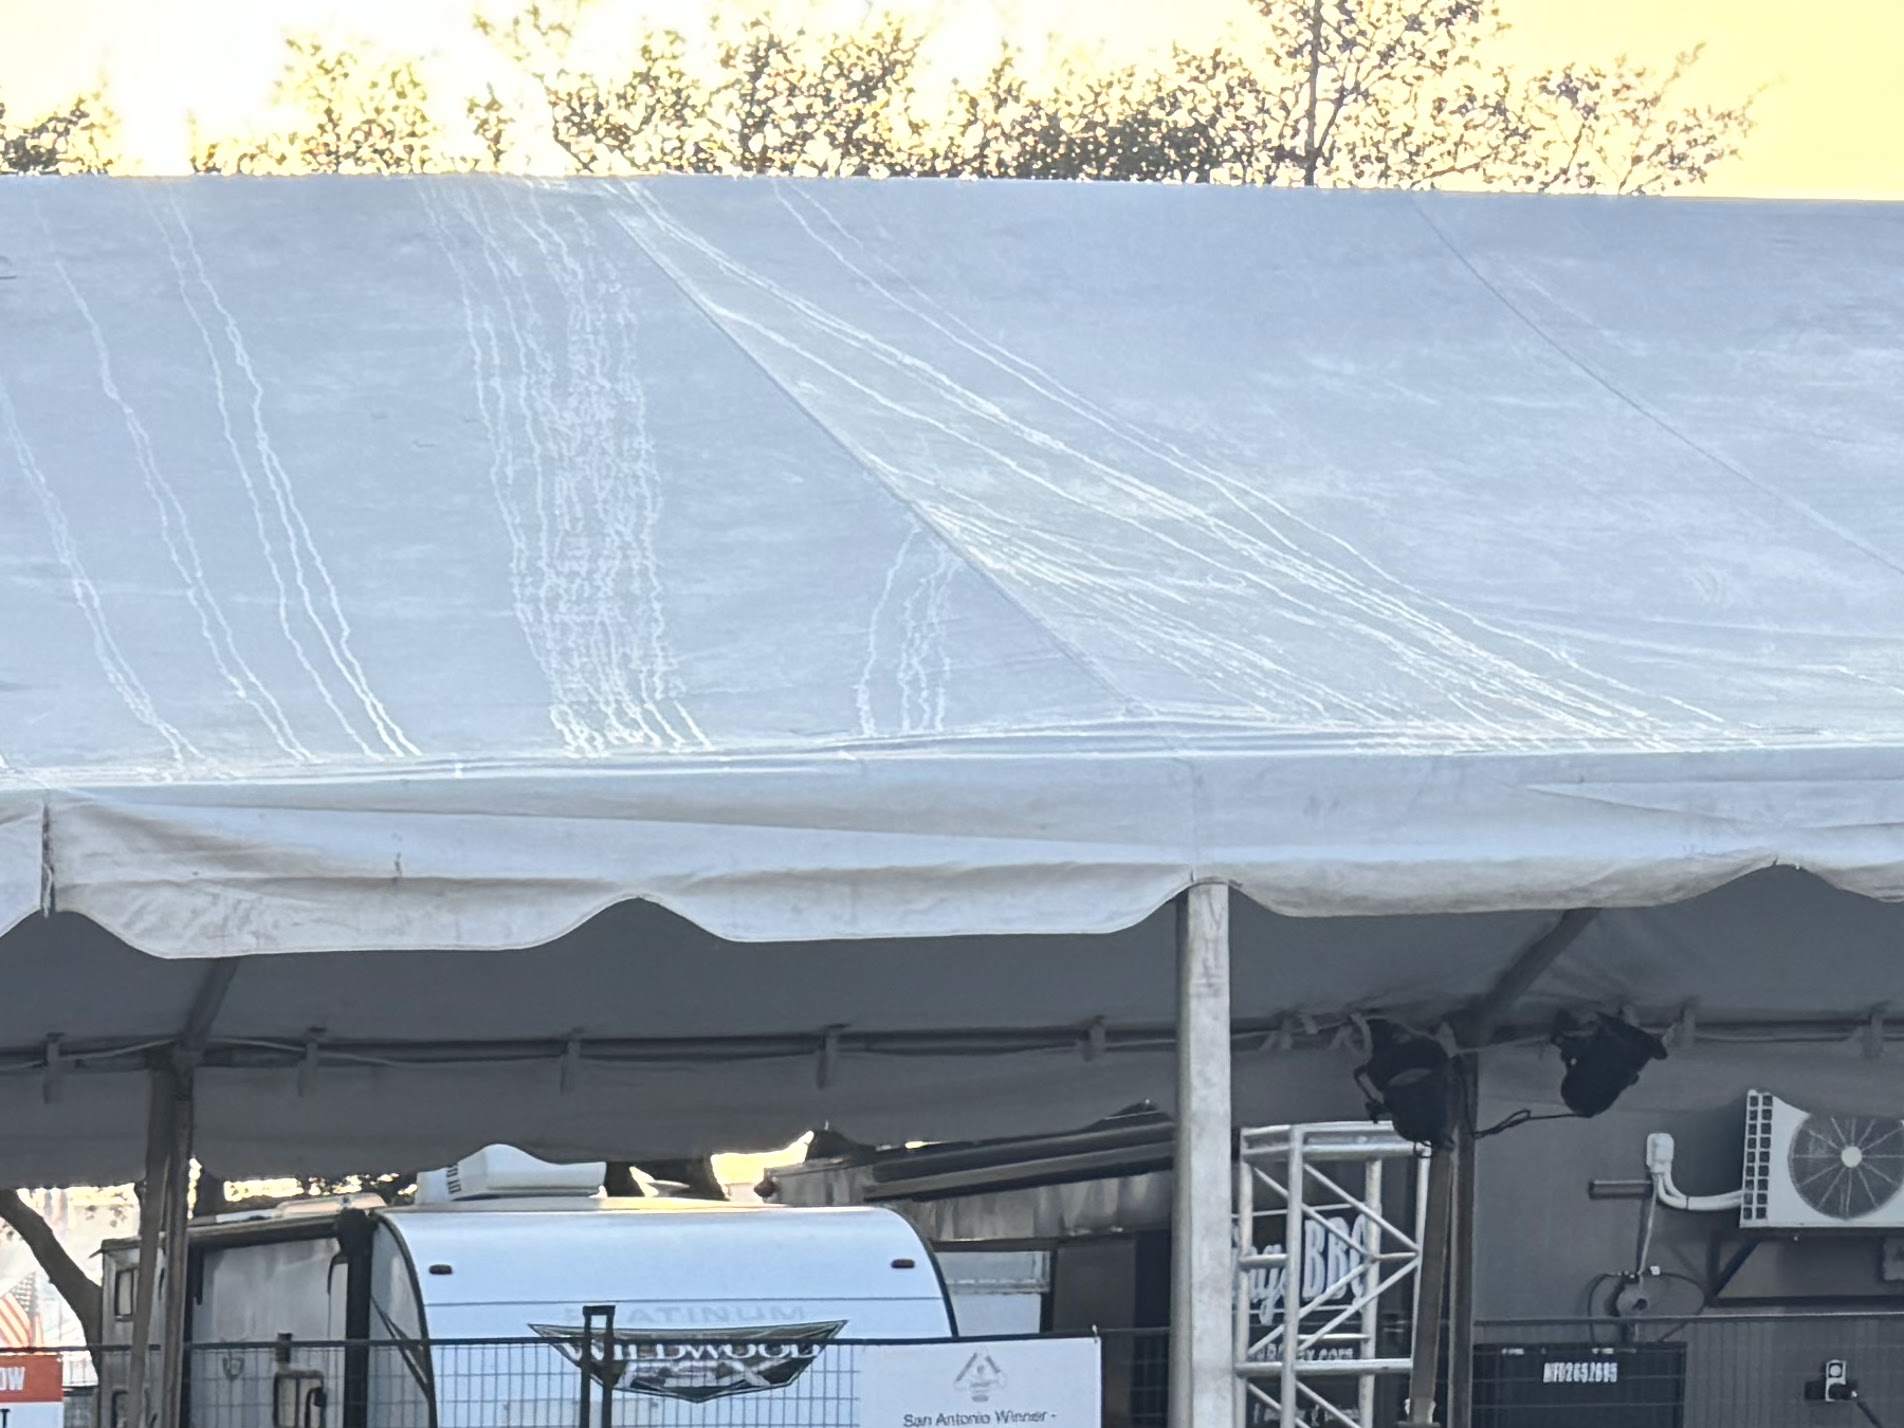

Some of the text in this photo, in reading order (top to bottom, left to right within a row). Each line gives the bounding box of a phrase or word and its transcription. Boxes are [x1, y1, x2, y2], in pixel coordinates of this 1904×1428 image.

[564, 1305, 806, 1325] PATINUM
[903, 1413, 932, 1428] San
[935, 1412, 992, 1427] Antonio
[994, 1409, 1048, 1424] Winner
